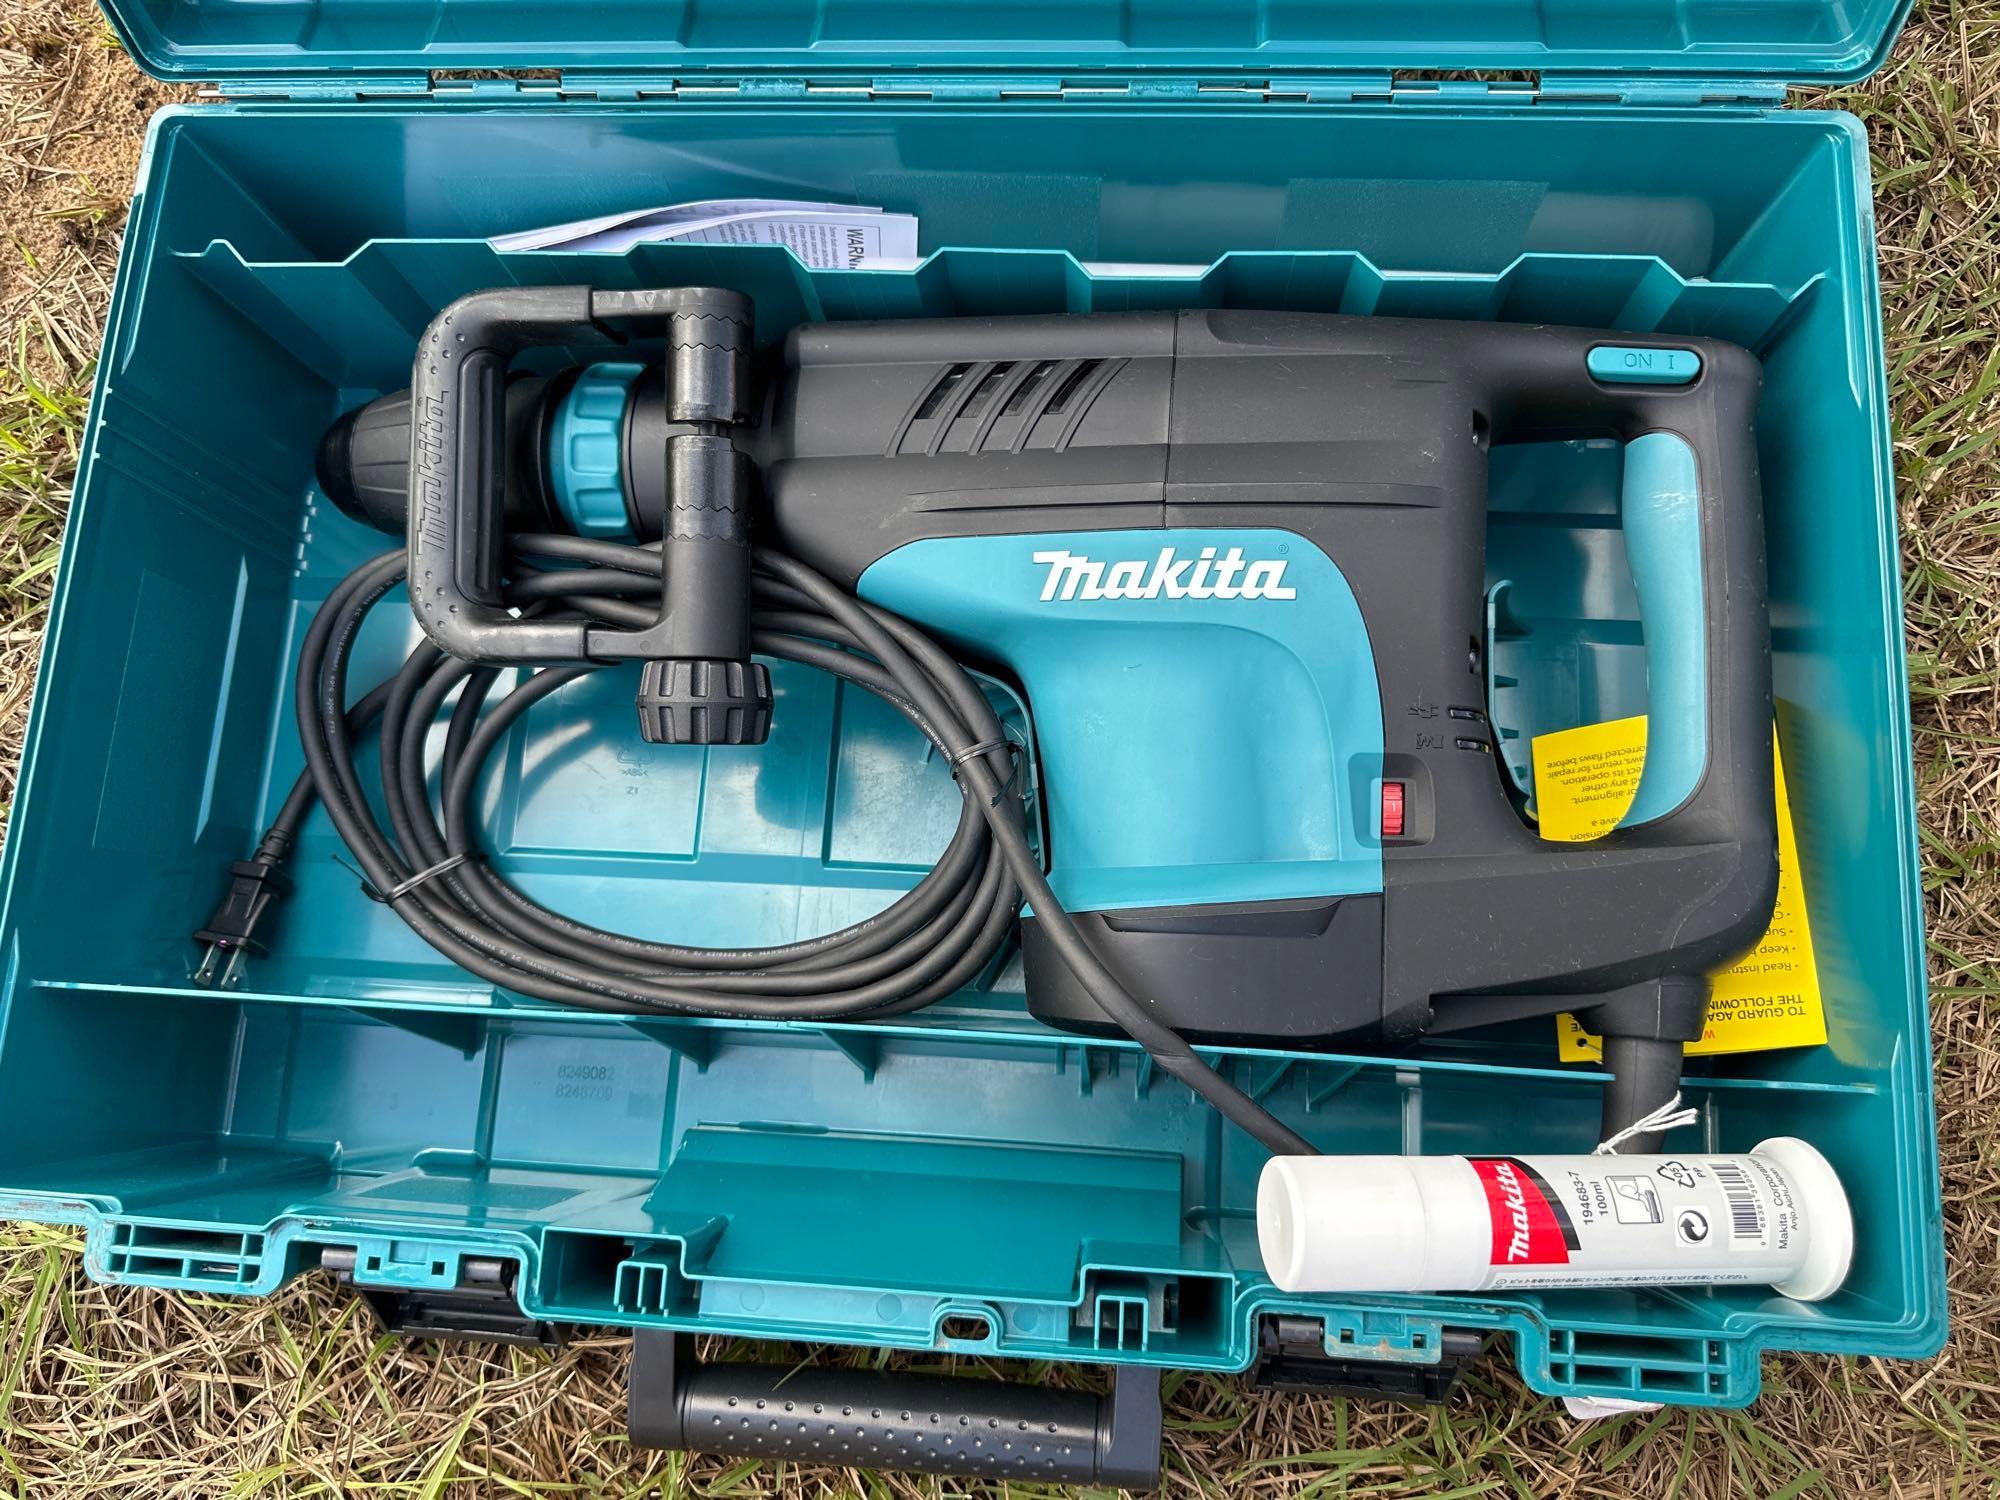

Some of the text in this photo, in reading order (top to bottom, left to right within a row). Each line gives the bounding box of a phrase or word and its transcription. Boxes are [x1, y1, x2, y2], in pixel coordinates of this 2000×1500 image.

[847, 229, 865, 269] WARN
[1624, 353, 1652, 368] ON
[1546, 745, 1645, 769] orrected flaws before
[1577, 765, 1591, 773] for
[1592, 760, 1623, 771] return
[1546, 768, 1575, 779] repair.
[1560, 771, 1610, 786] operation.
[1581, 782, 1608, 792] other
[1611, 777, 1628, 787] any
[1570, 829, 1609, 840] tension
[1760, 945, 1789, 955] Keep
[1763, 962, 1792, 971] Read
[1709, 994, 1804, 1010] THE FOLLOWIN
[1738, 1007, 1784, 1020] GUARD
[1787, 1005, 1806, 1016] TO
[1693, 1167, 1707, 1178] PP
[1568, 1171, 1594, 1225] 194683-7
[1589, 1182, 1608, 1216] 100ml
[1748, 1158, 1788, 1249] Makita Corporation
